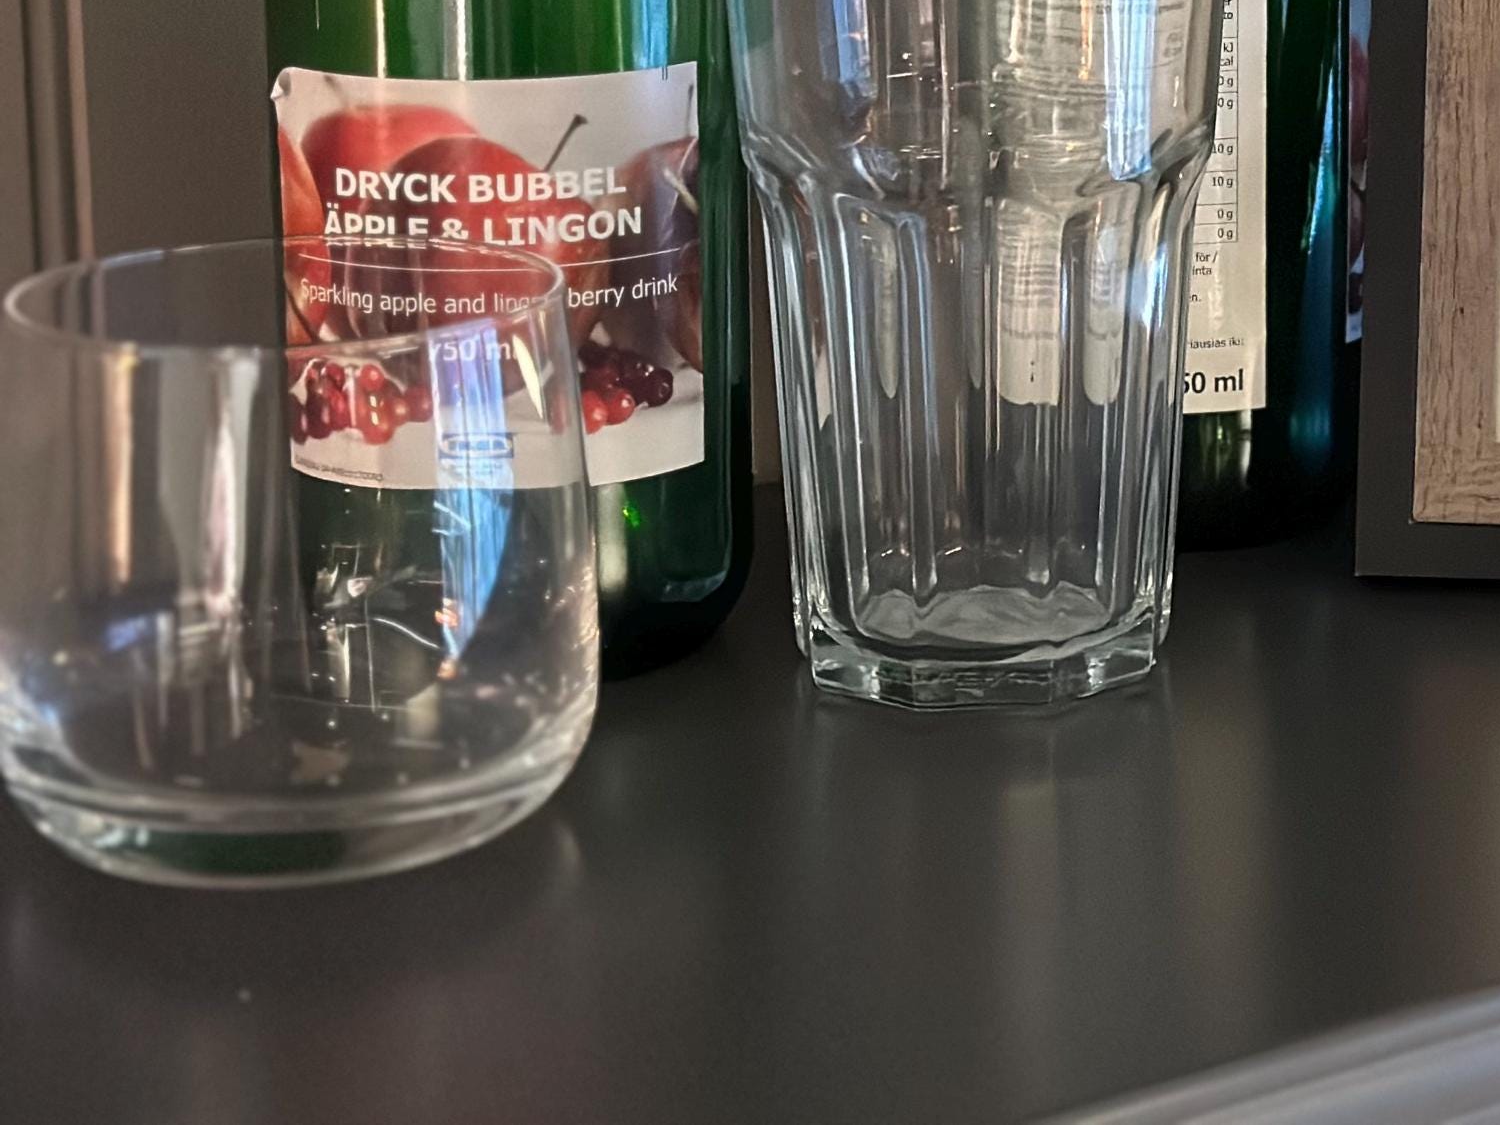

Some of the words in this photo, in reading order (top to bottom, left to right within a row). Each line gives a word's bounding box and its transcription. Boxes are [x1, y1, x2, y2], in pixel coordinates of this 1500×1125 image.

[335, 167, 457, 204] DRYCK
[468, 166, 627, 203] BUBBEL
[1212, 177, 1224, 187] 10
[441, 218, 469, 240] &
[482, 206, 643, 246] LINGON
[1217, 209, 1224, 219] 0
[1217, 229, 1224, 238] 0
[300, 278, 373, 313] Sparkling
[380, 294, 437, 316] apple
[444, 293, 486, 313] and
[631, 272, 678, 301] drink
[1214, 368, 1243, 393] ml
